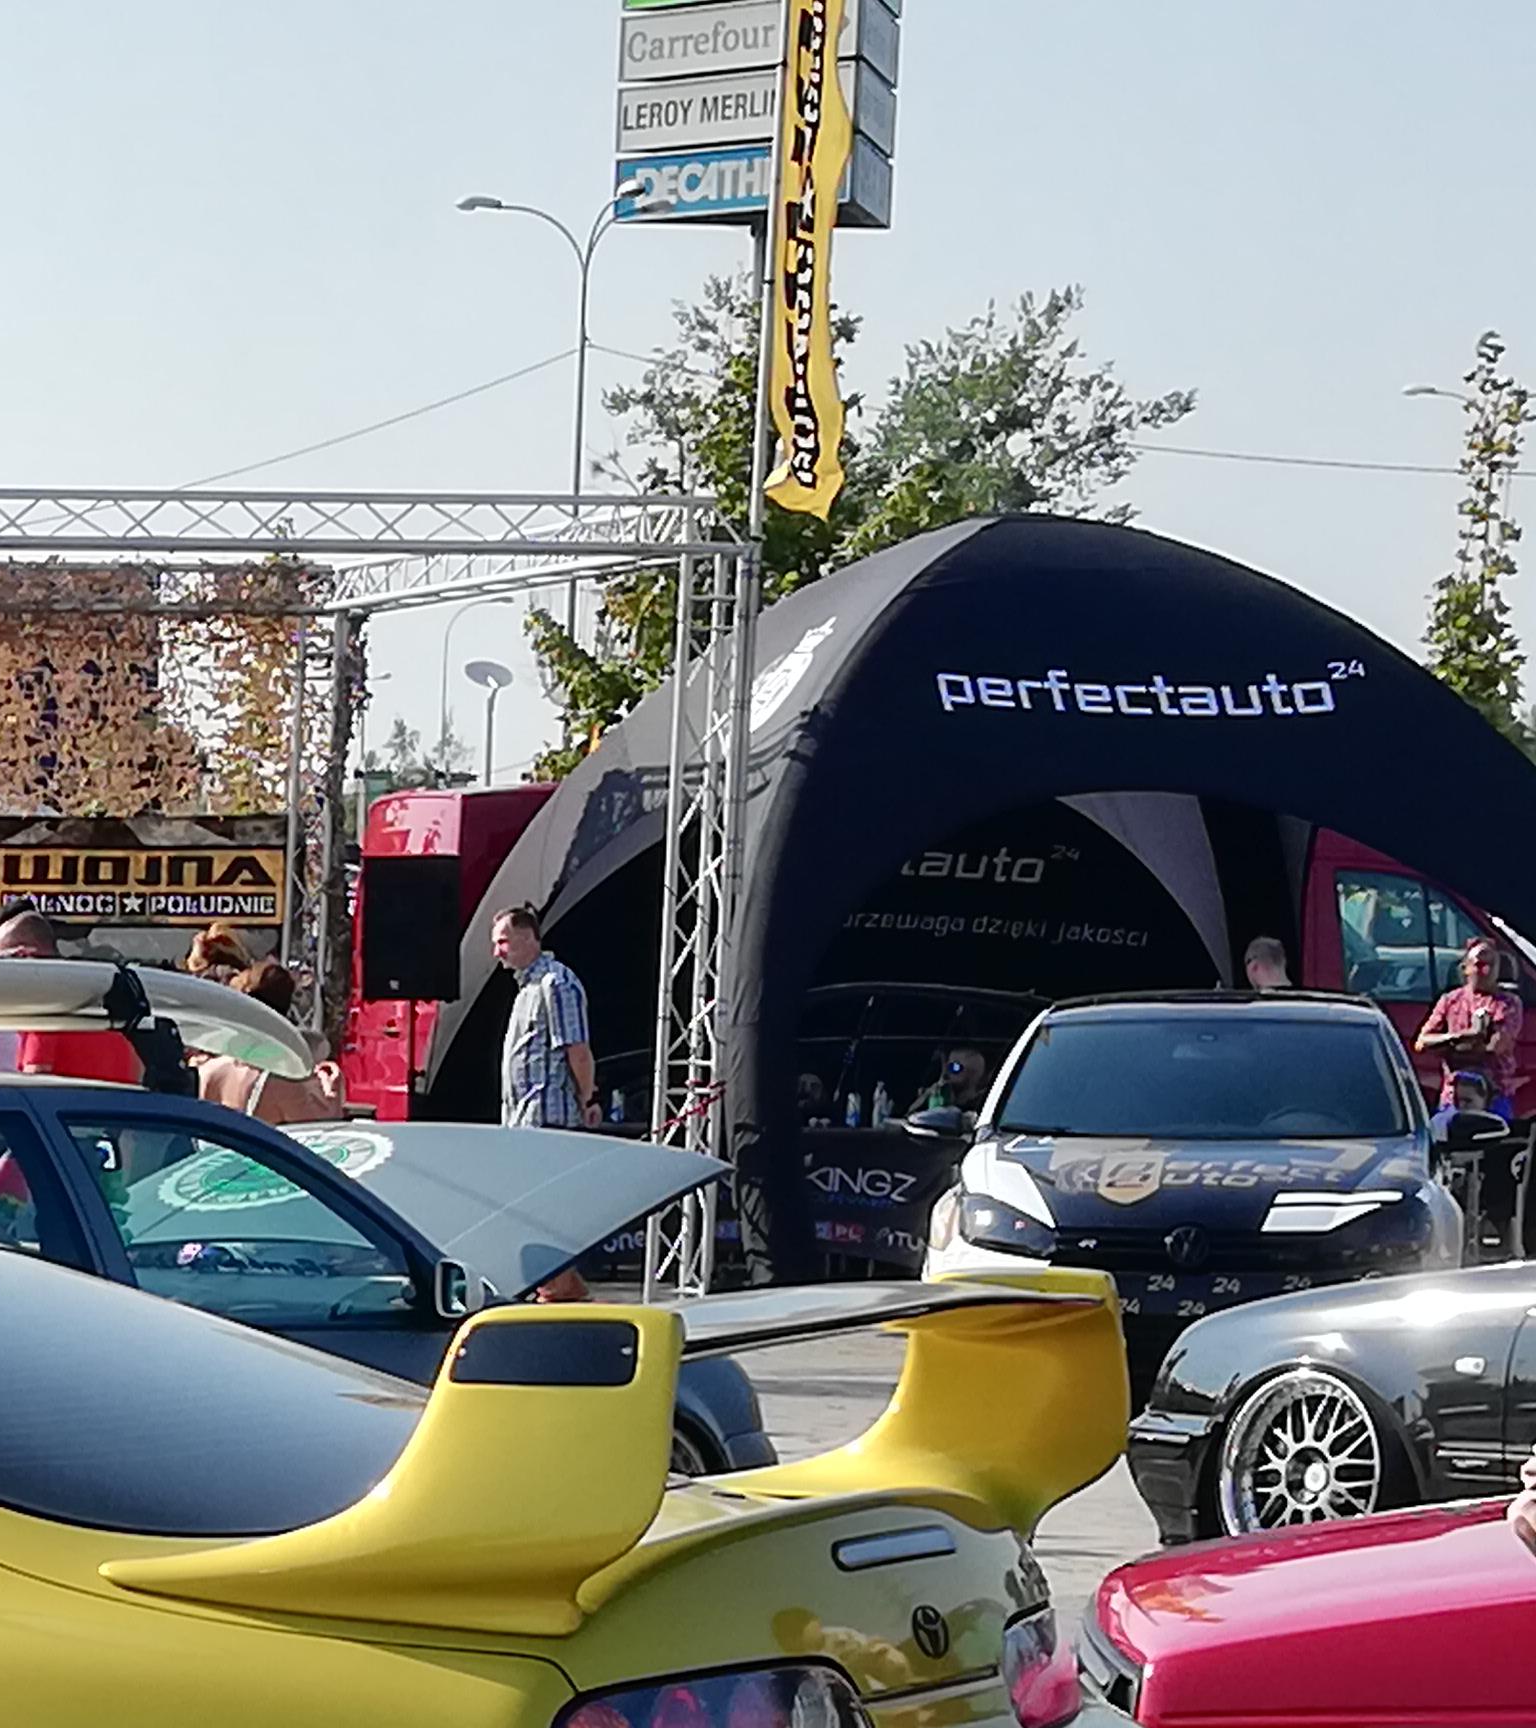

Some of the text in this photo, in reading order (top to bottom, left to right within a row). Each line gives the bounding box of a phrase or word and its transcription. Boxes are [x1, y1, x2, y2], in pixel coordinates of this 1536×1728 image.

[628, 20, 776, 63] Carrefour
[622, 98, 694, 131] LEROY
[936, 659, 1366, 717] perfectauto 24
[3, 855, 276, 886] WOJNA
[150, 895, 274, 914] POŁUDNIE
